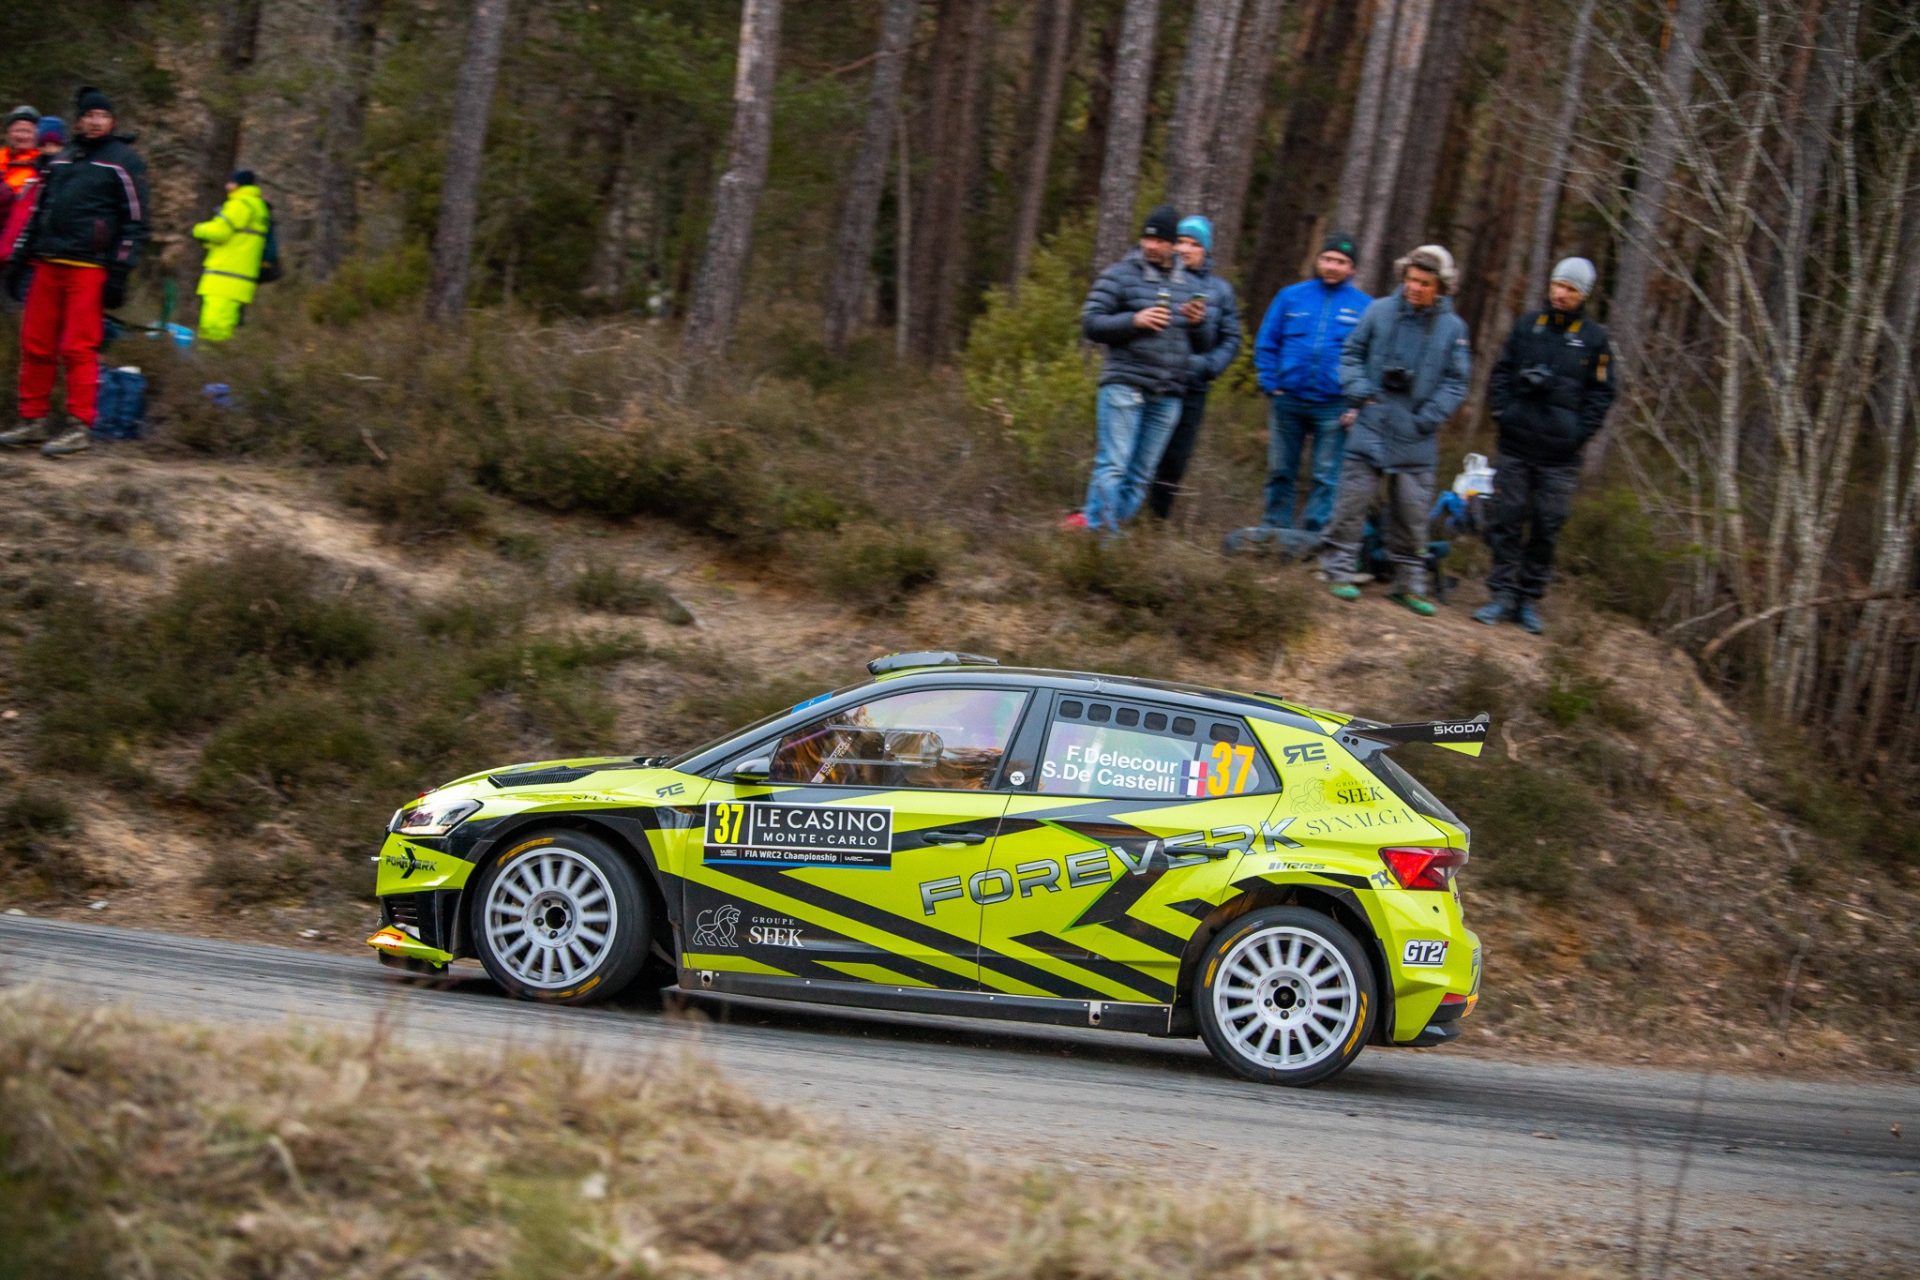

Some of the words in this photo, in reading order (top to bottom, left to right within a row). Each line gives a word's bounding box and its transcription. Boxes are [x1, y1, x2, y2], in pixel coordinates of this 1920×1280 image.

[1066, 745, 1179, 775] F.Delecour
[1207, 741, 1256, 796] 37
[1097, 768, 1176, 793] Castelli
[714, 803, 745, 844] 37
[756, 808, 782, 828] LE
[787, 810, 886, 832] CASINO
[744, 850, 758, 858] FIA
[759, 850, 782, 859] WRC2
[783, 851, 838, 863] Championship
[918, 817, 1304, 916] FOREVERK
[752, 916, 795, 926] GROUPE
[748, 926, 805, 948] SEEK
